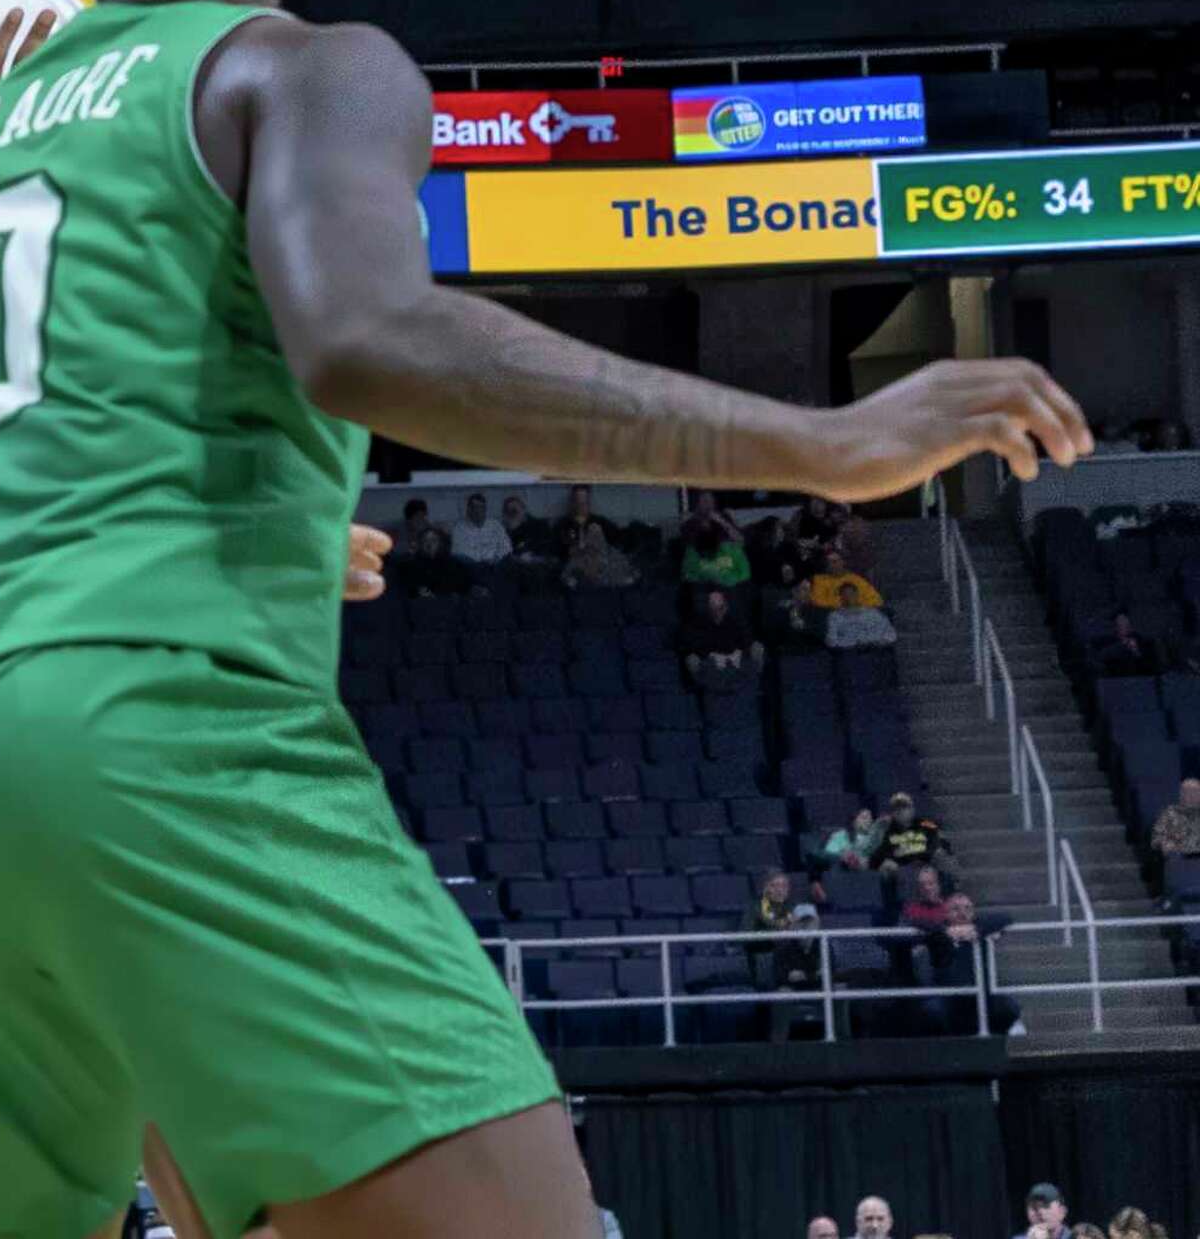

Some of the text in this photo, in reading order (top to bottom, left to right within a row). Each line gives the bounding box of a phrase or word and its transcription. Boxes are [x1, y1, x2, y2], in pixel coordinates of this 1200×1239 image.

[431, 112, 526, 146] Bank
[773, 107, 816, 128] GET
[818, 105, 864, 125] OUT
[865, 101, 923, 122] THER
[611, 198, 707, 239] The
[904, 182, 1018, 223] FG%:
[1042, 177, 1095, 216] 34
